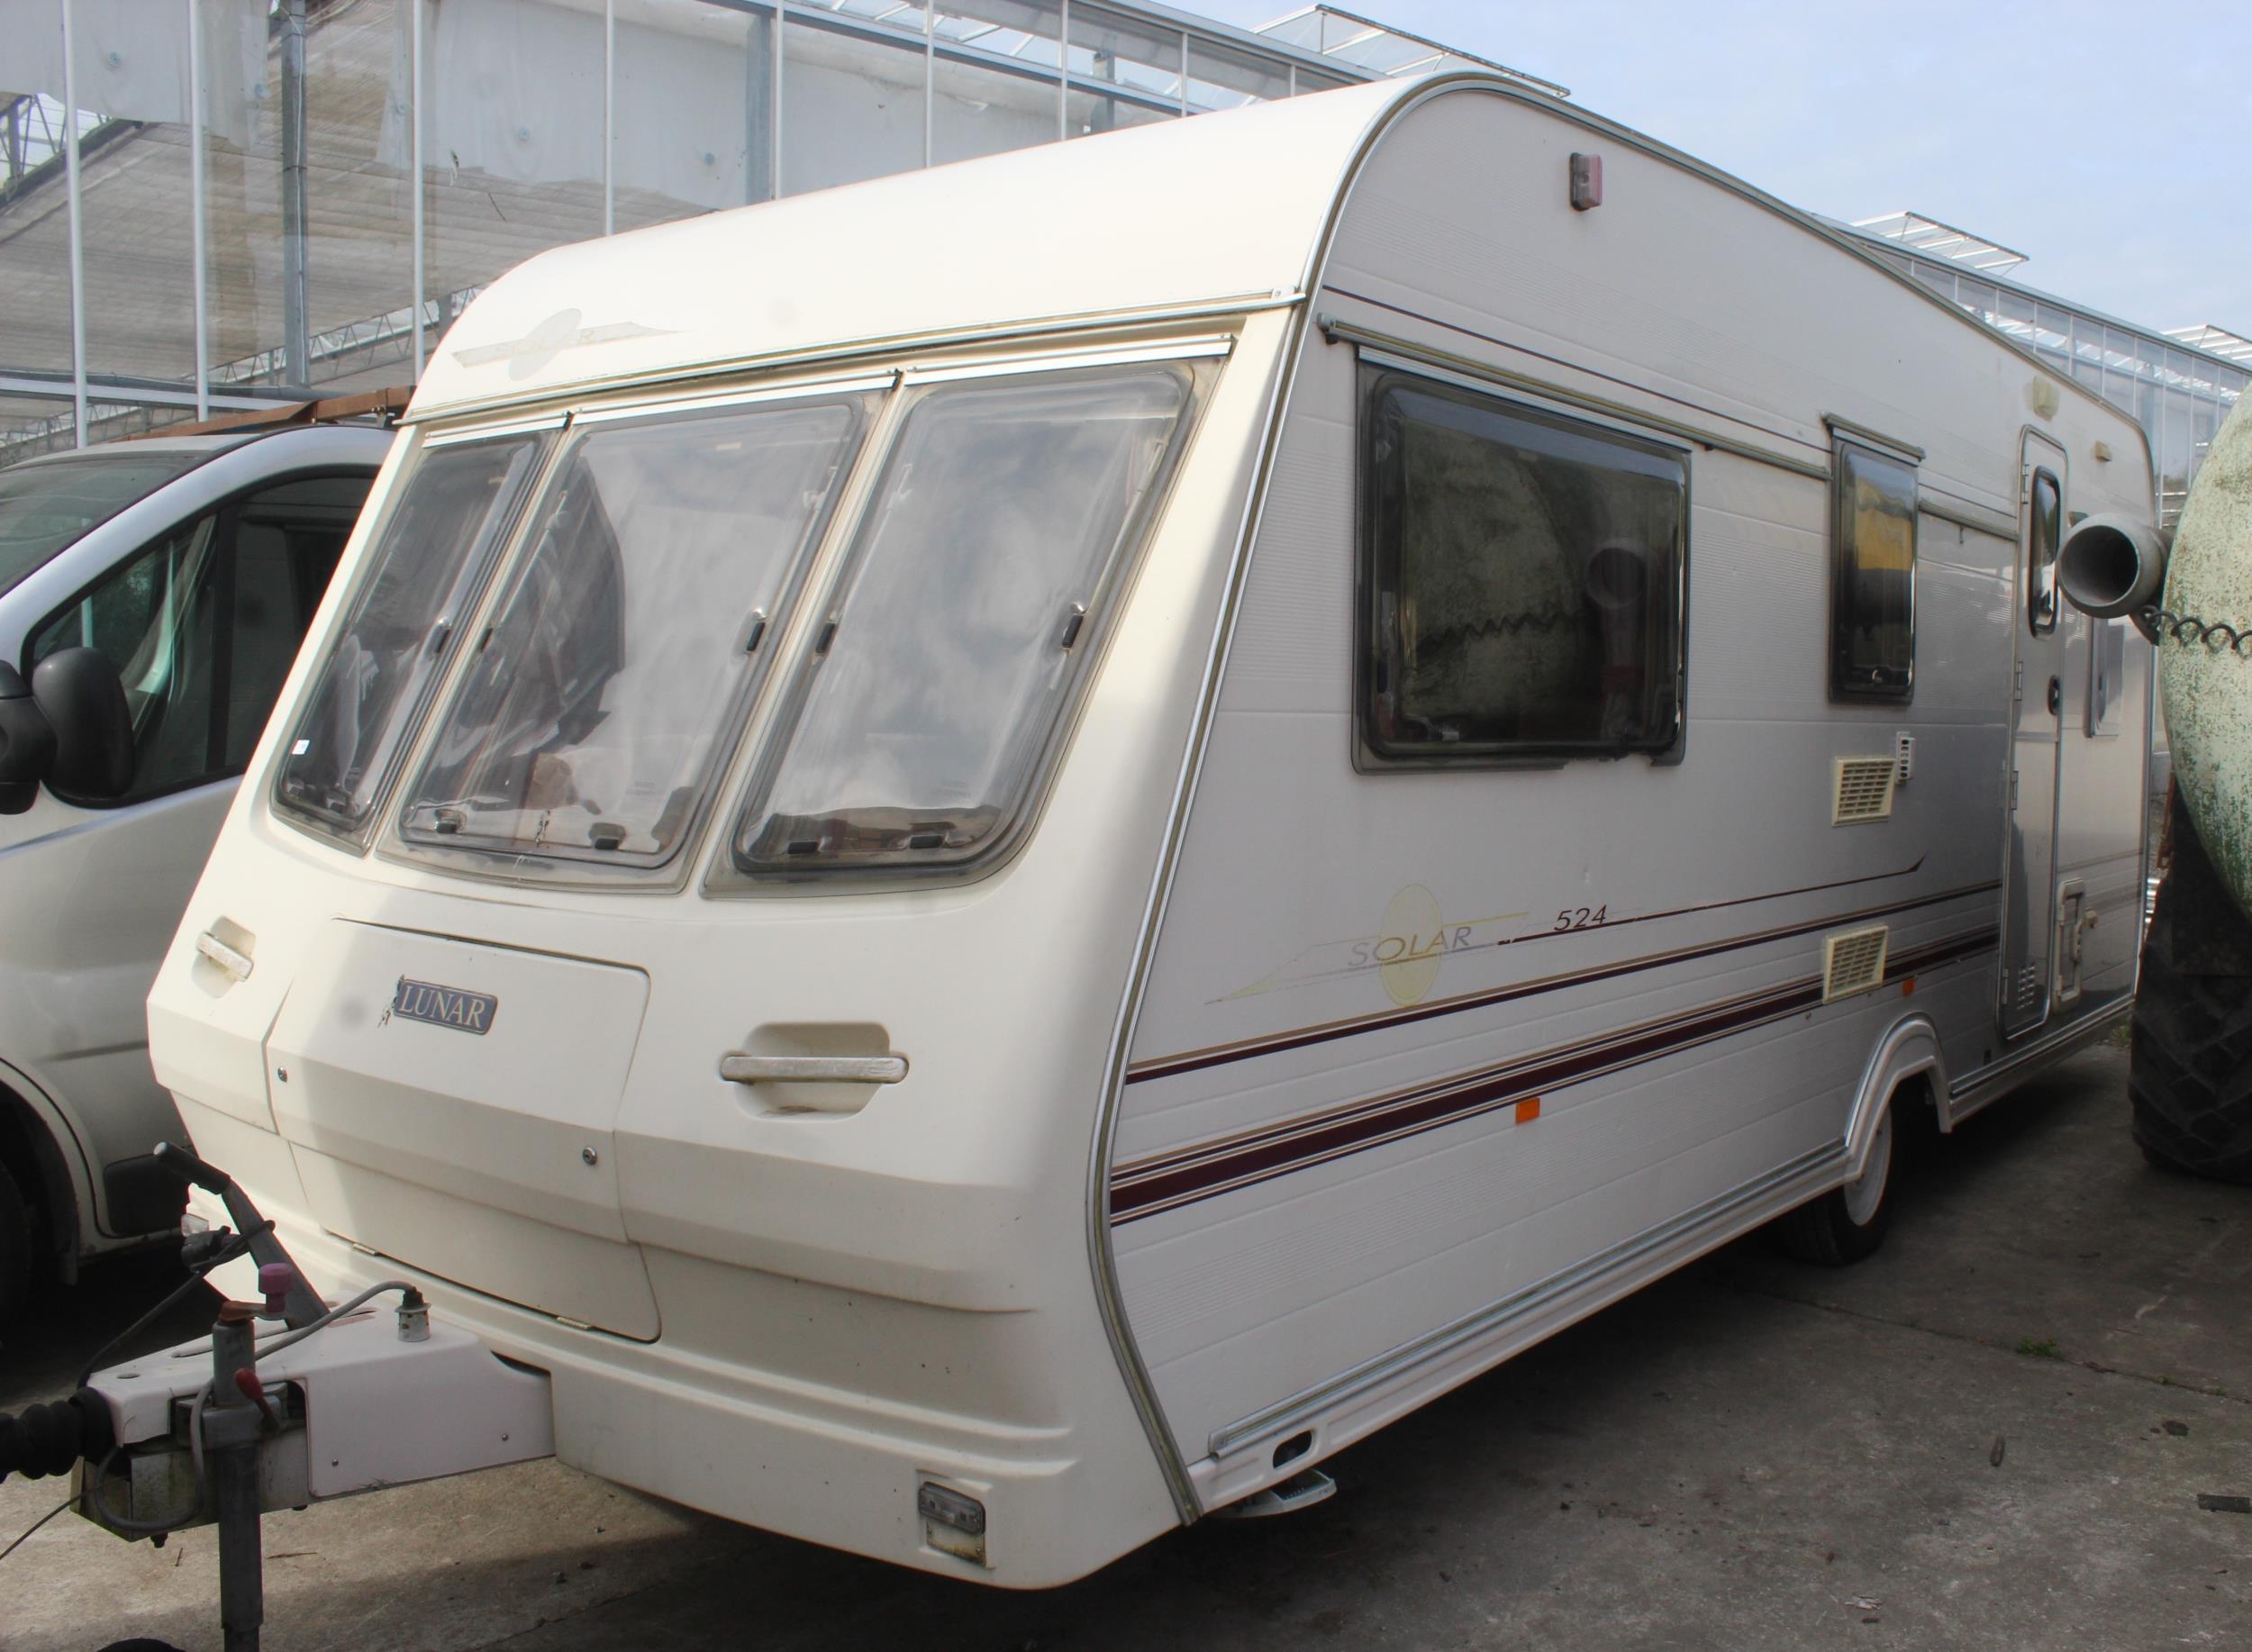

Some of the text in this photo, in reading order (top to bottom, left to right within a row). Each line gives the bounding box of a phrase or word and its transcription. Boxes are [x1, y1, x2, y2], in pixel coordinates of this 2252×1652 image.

[1348, 904, 1607, 967] SOLAR 524
[398, 985, 486, 1029] LUNAR
